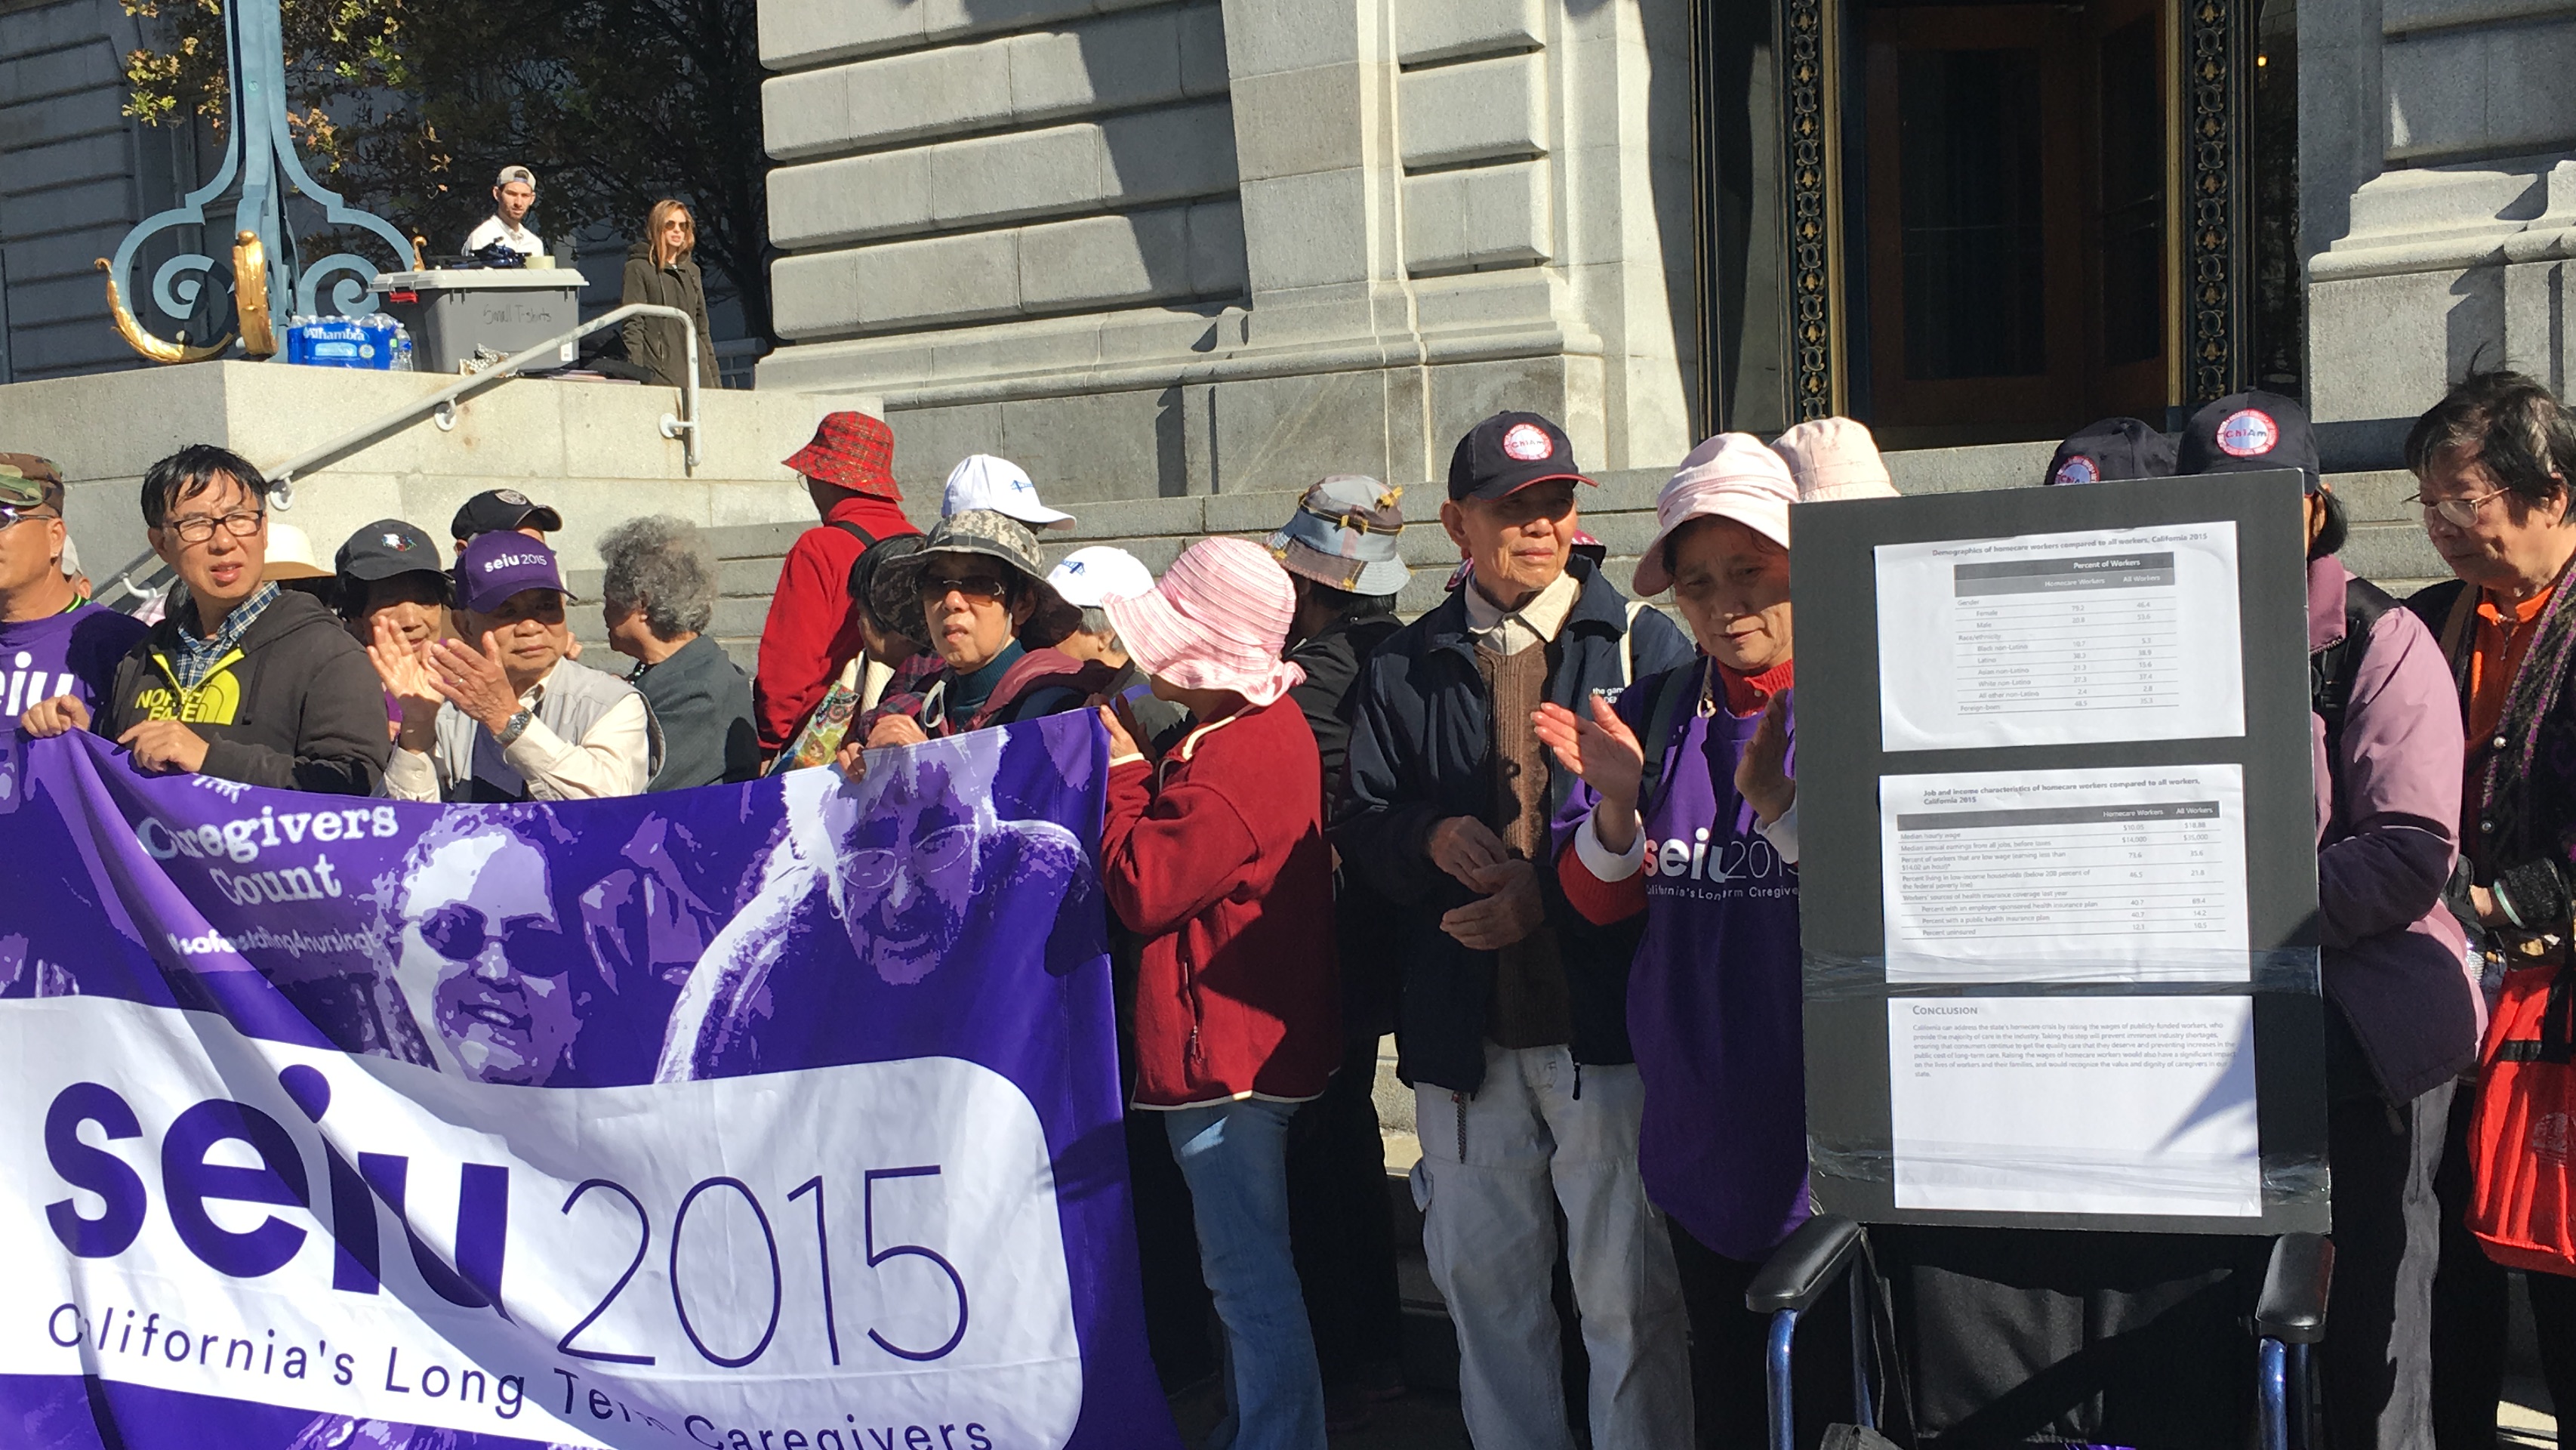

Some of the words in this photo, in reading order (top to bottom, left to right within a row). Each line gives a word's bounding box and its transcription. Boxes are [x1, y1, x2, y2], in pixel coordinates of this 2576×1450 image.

[307, 326, 365, 341] Alhambra
[1932, 547, 1983, 556] Demographics
[2060, 540, 2096, 549] compared
[485, 554, 520, 572] seiu
[520, 554, 547, 566] 2015
[1980, 785, 2031, 794] characteristics
[2109, 780, 2146, 788] compared
[1924, 797, 1957, 805] California
[1725, 841, 1798, 878] 201
[208, 853, 342, 906] Count
[1912, 1005, 1978, 1015] CONCLUSION
[45, 1064, 520, 1327] seiu
[557, 1165, 969, 1368] 2015
[385, 1347, 525, 1420] Long
